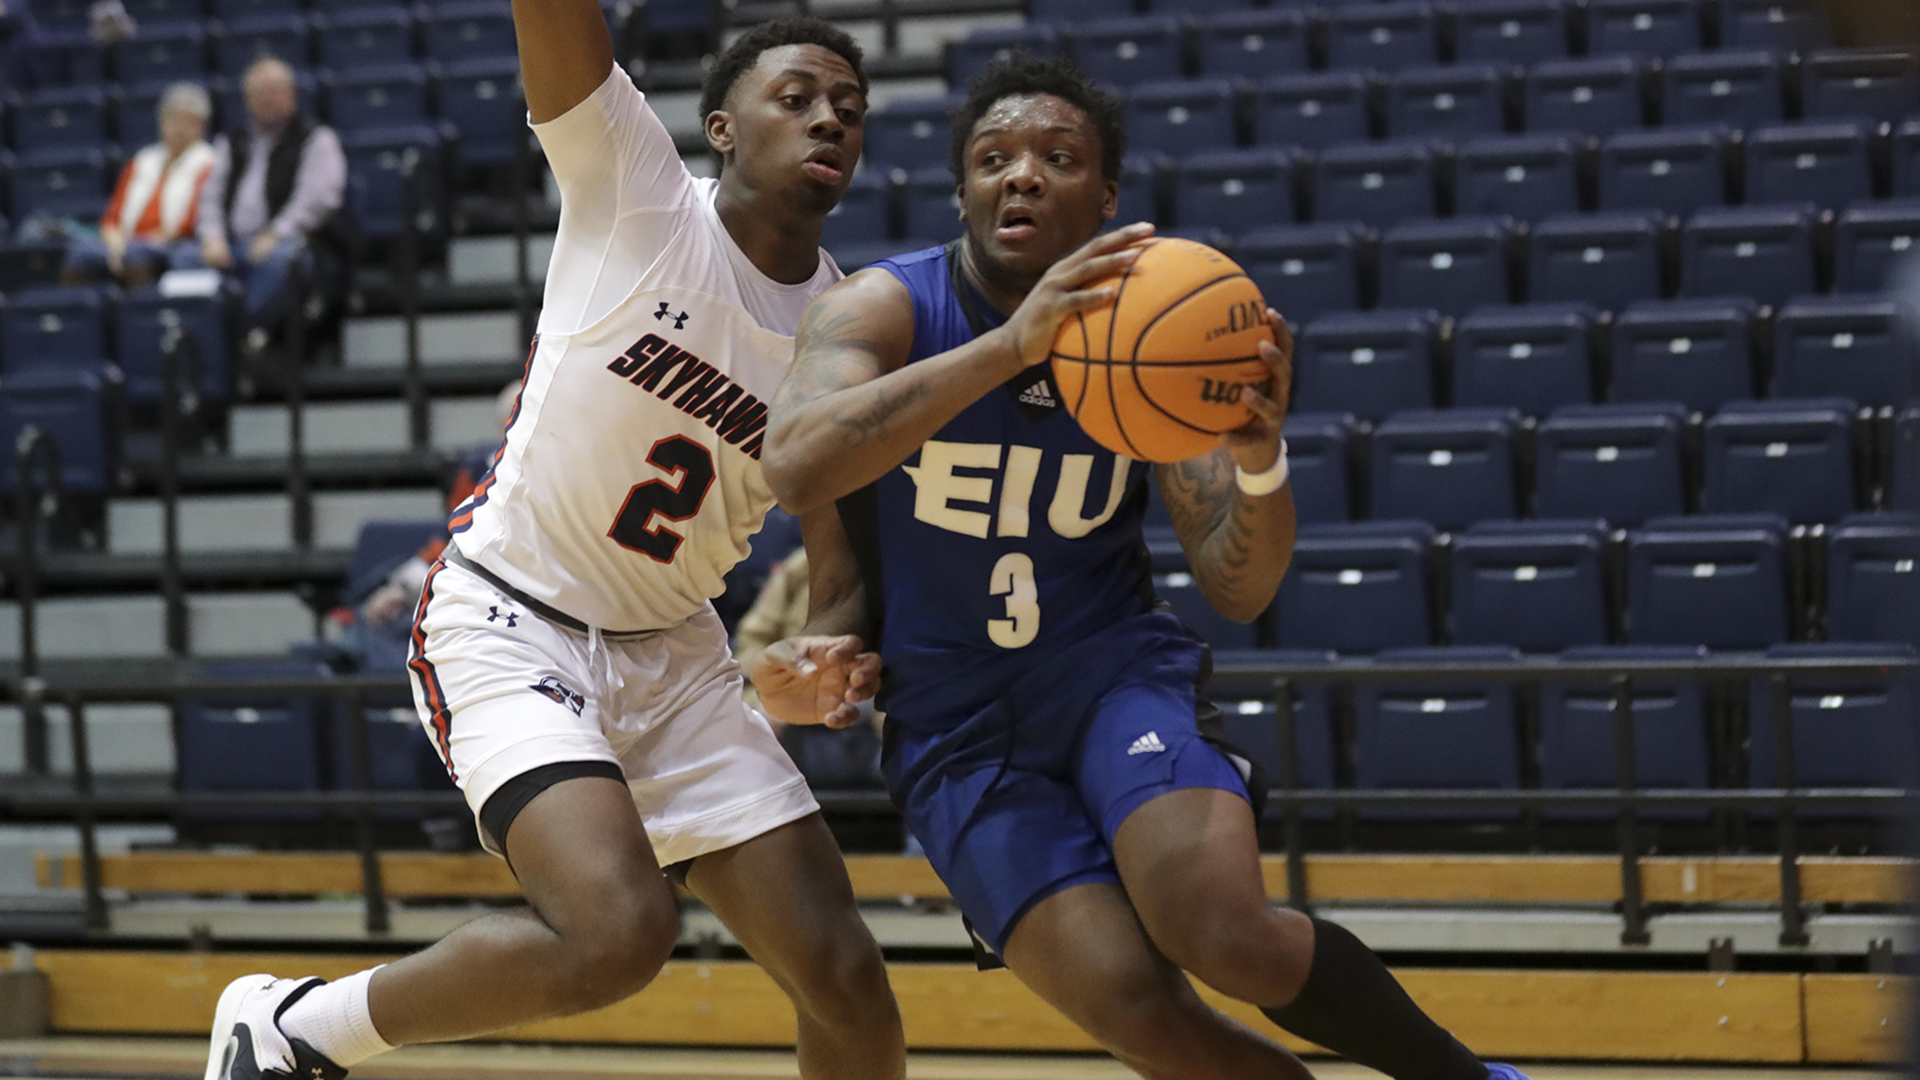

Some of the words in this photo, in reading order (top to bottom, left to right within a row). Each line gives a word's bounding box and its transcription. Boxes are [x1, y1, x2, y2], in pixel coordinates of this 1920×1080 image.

[1018, 394, 1056, 408] adidas
[606, 433, 717, 565] 2
[901, 440, 1132, 540] EIU
[987, 552, 1041, 649] 3
[1127, 743, 1166, 756] adidas
